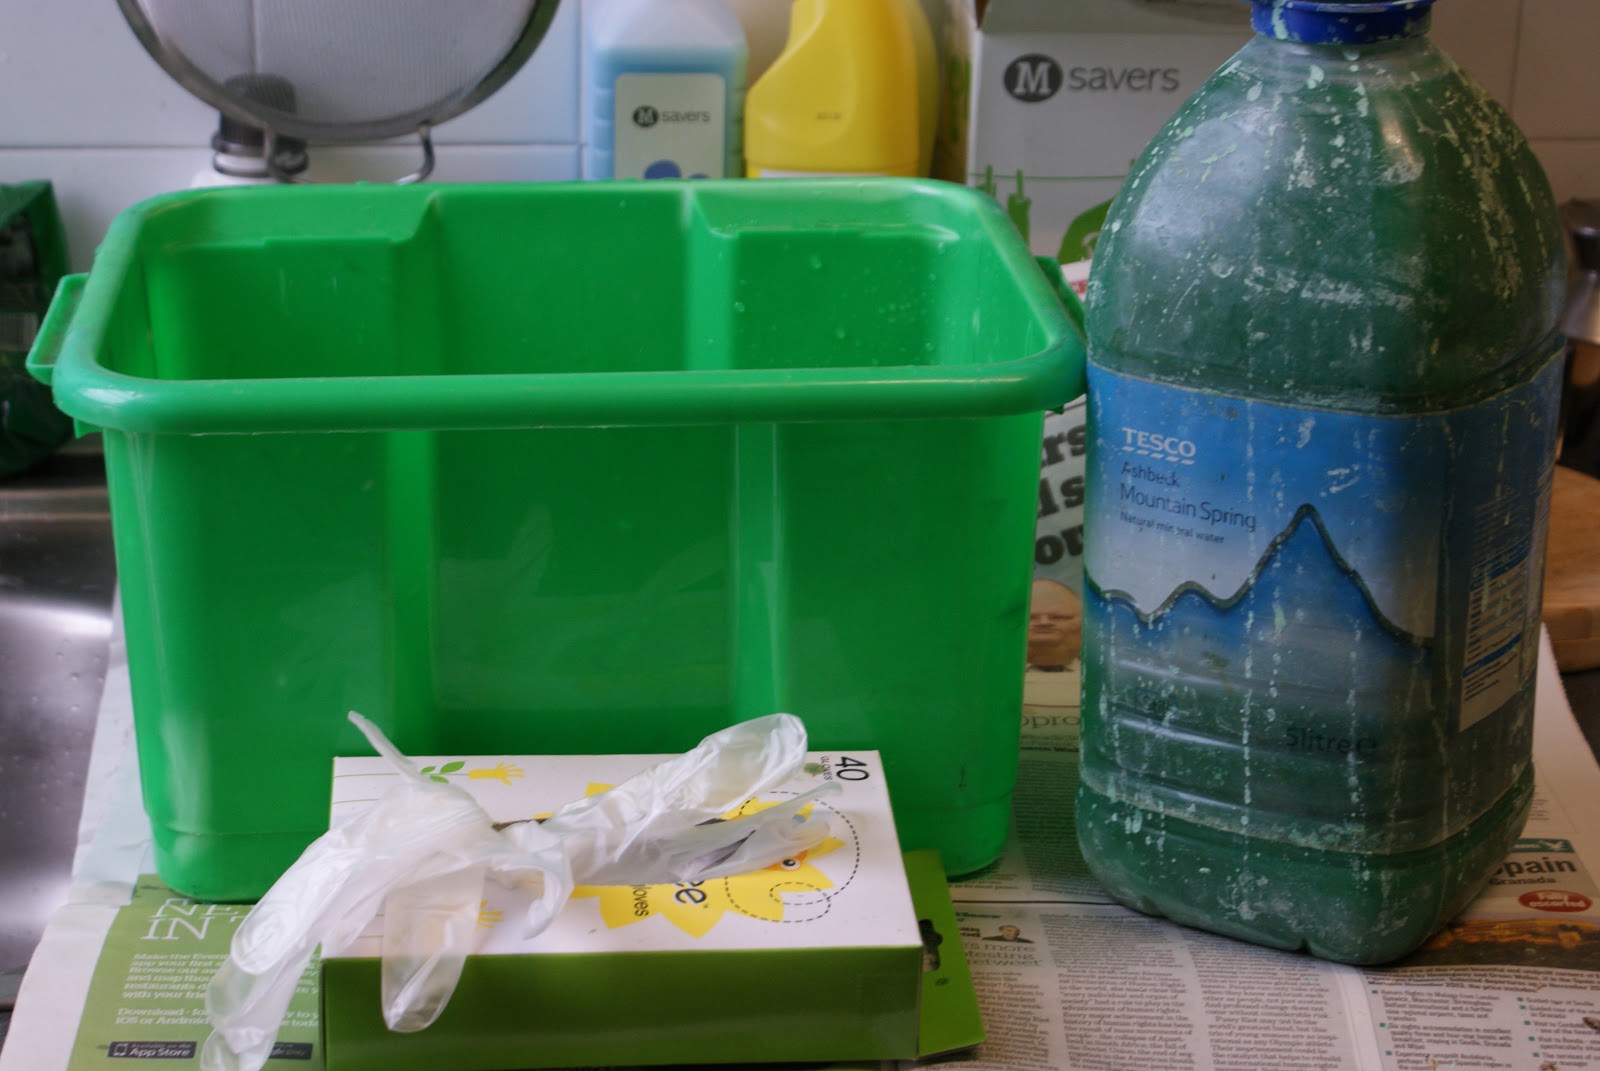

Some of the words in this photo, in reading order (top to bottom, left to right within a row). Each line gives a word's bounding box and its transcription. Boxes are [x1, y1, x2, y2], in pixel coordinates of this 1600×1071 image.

[1011, 59, 1053, 97] M
[1068, 66, 1180, 92] savers
[661, 109, 711, 123] savers
[1121, 427, 1197, 458] TESCO
[1120, 460, 1181, 488] Ashbeck
[1119, 482, 1198, 518] Mountain
[1199, 501, 1257, 533] Spring
[1119, 510, 1155, 528] Natural
[1195, 529, 1226, 544] water
[835, 755, 870, 781] 40
[129, 1047, 160, 1060] App
[159, 1047, 193, 1059] Store
